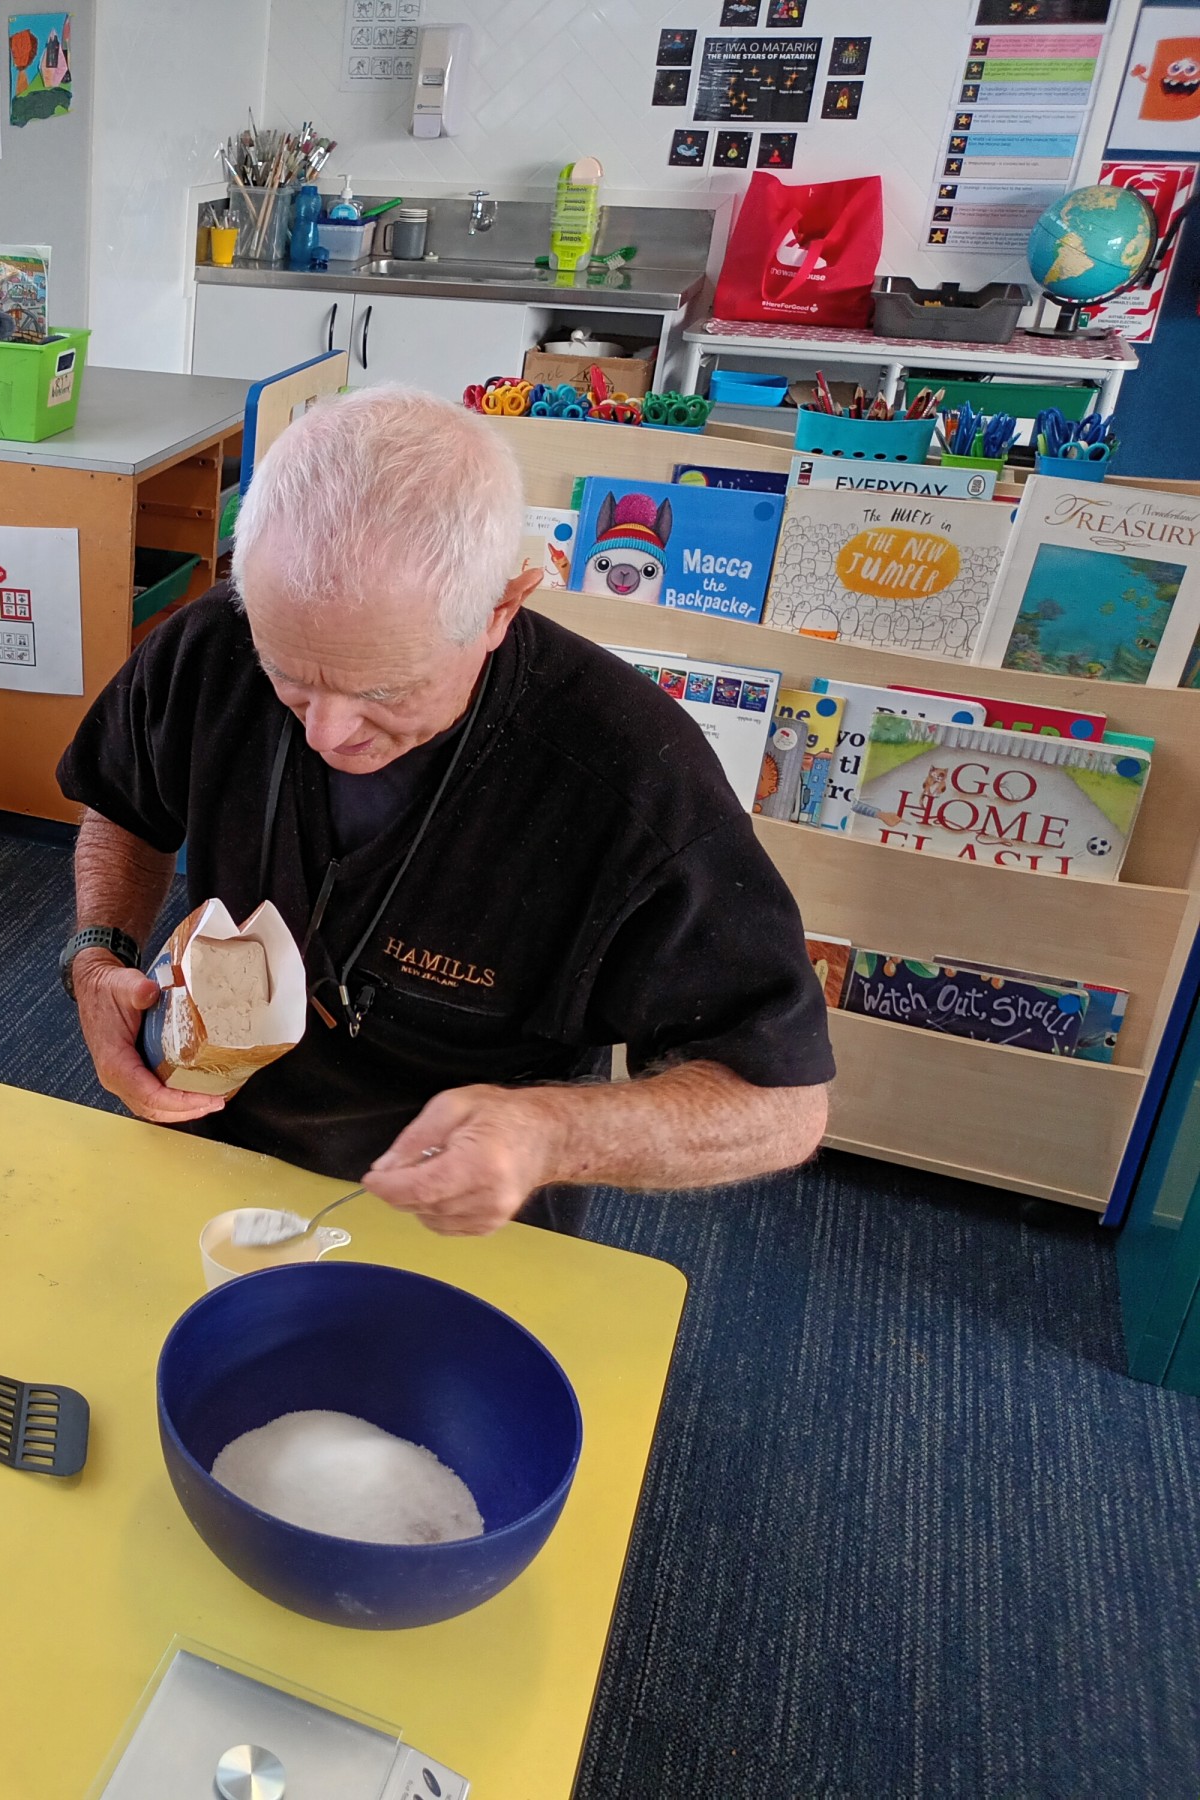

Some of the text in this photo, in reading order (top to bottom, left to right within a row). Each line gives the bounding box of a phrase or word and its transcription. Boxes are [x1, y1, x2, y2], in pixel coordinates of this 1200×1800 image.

[708, 42, 818, 52] TE IWA O MATARIKI
[762, 300, 810, 312] #HereForGood
[836, 476, 948, 497] EVERYDAY
[863, 508, 881, 523] The
[941, 519, 952, 532] in
[1044, 493, 1200, 546] TREASURY
[865, 531, 950, 564] THE NEW
[682, 548, 753, 579] Macca
[845, 551, 940, 593] JUMPER
[702, 577, 727, 593] the
[665, 588, 756, 618] Backpacker
[950, 762, 1038, 803] GO
[897, 790, 1069, 850] HOME
[384, 937, 496, 987] HAMILLS
[401, 965, 460, 988] NEW ZEALAND
[862, 982, 1075, 1036] Watch Out, Snail!
